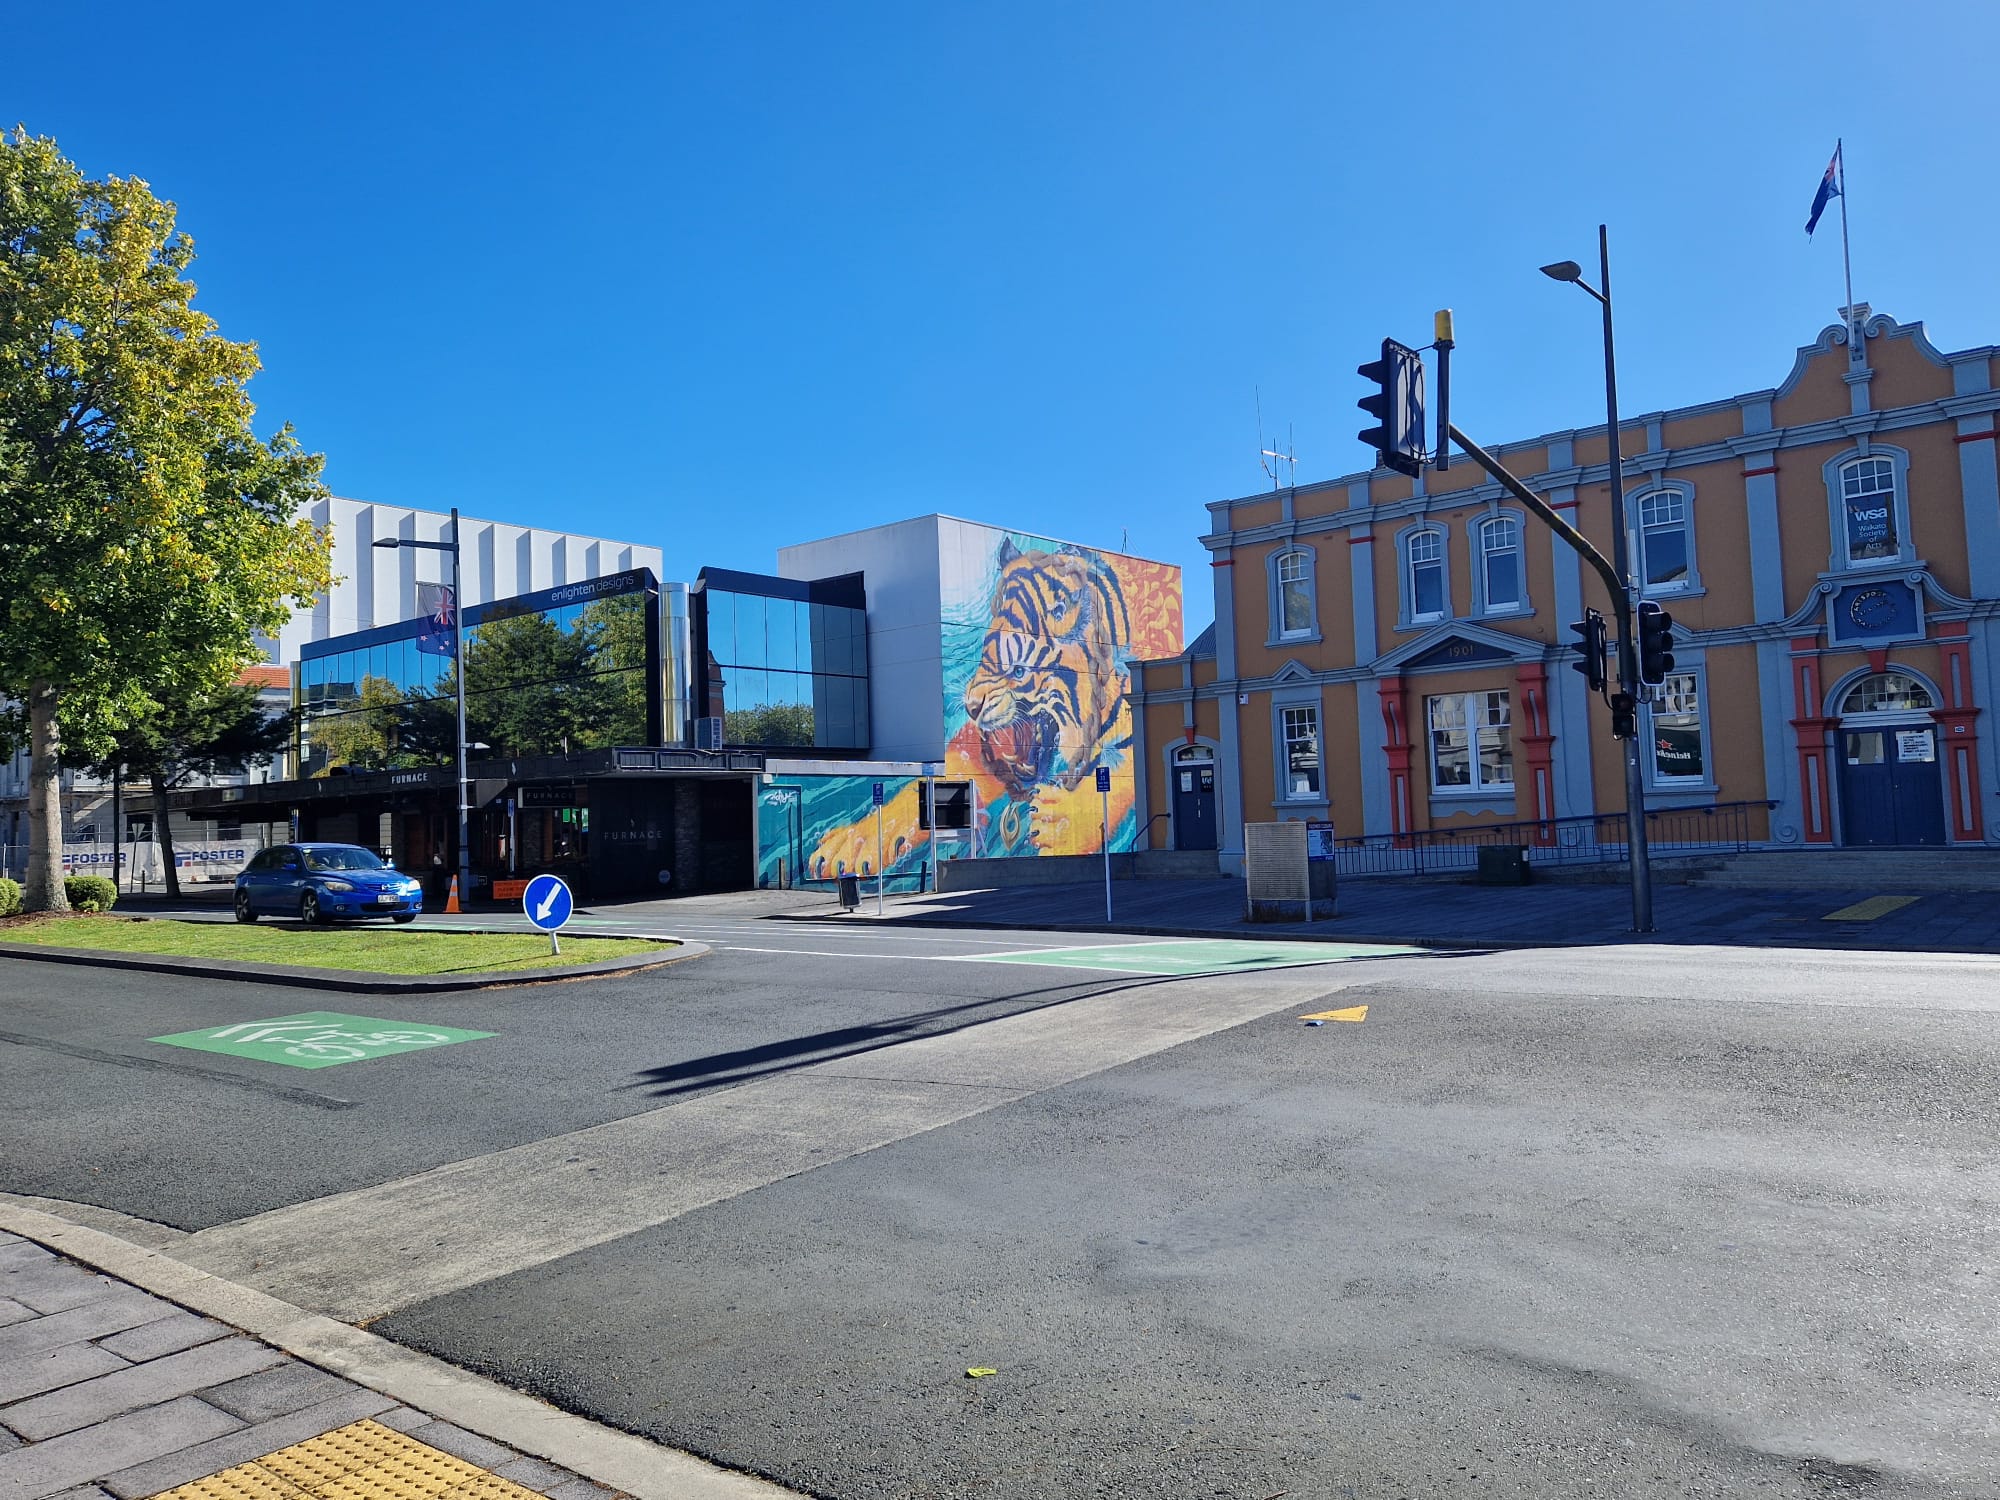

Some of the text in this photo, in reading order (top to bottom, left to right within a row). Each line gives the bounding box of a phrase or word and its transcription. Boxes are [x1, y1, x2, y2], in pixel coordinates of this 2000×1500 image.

[1854, 507, 1888, 521] wsa
[1858, 523, 1887, 532] Waikato
[551, 575, 634, 601] enlighten designs
[1449, 645, 1474, 657] 1901
[391, 772, 429, 784] FURNACE
[604, 830, 664, 841] FURNACE
[192, 849, 245, 860] FOSTER
